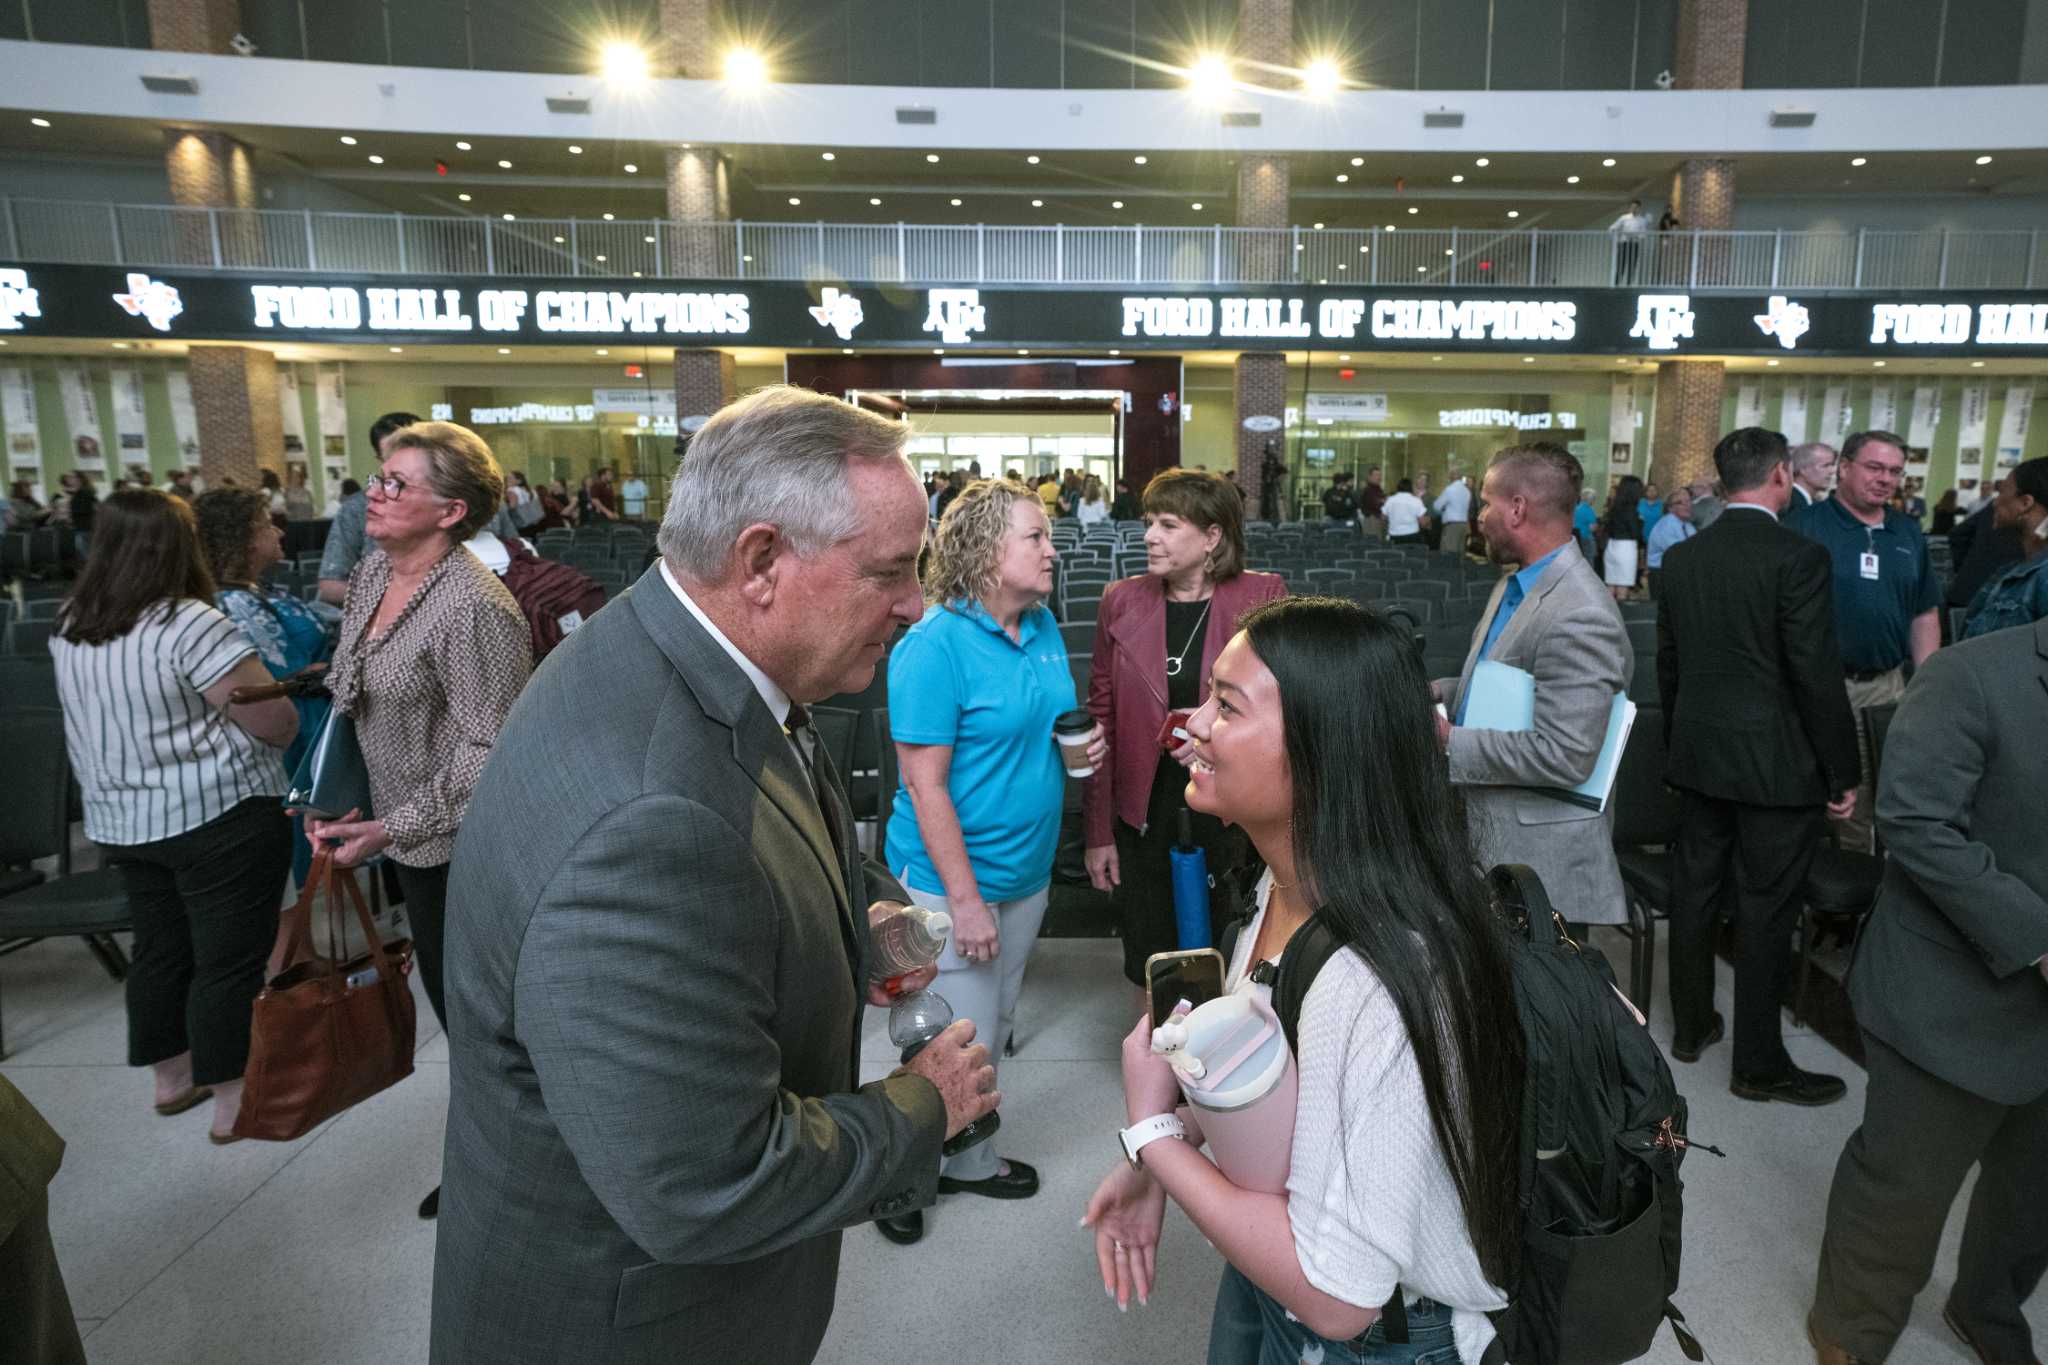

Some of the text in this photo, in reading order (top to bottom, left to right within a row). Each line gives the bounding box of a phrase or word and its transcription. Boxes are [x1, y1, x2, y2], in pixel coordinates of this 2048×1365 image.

[251, 286, 749, 333] FORD HALL OF CHAMPIONS
[1122, 298, 1576, 340] FORD HALL OF CHAMPIONS
[1871, 305, 1971, 343] FORD
